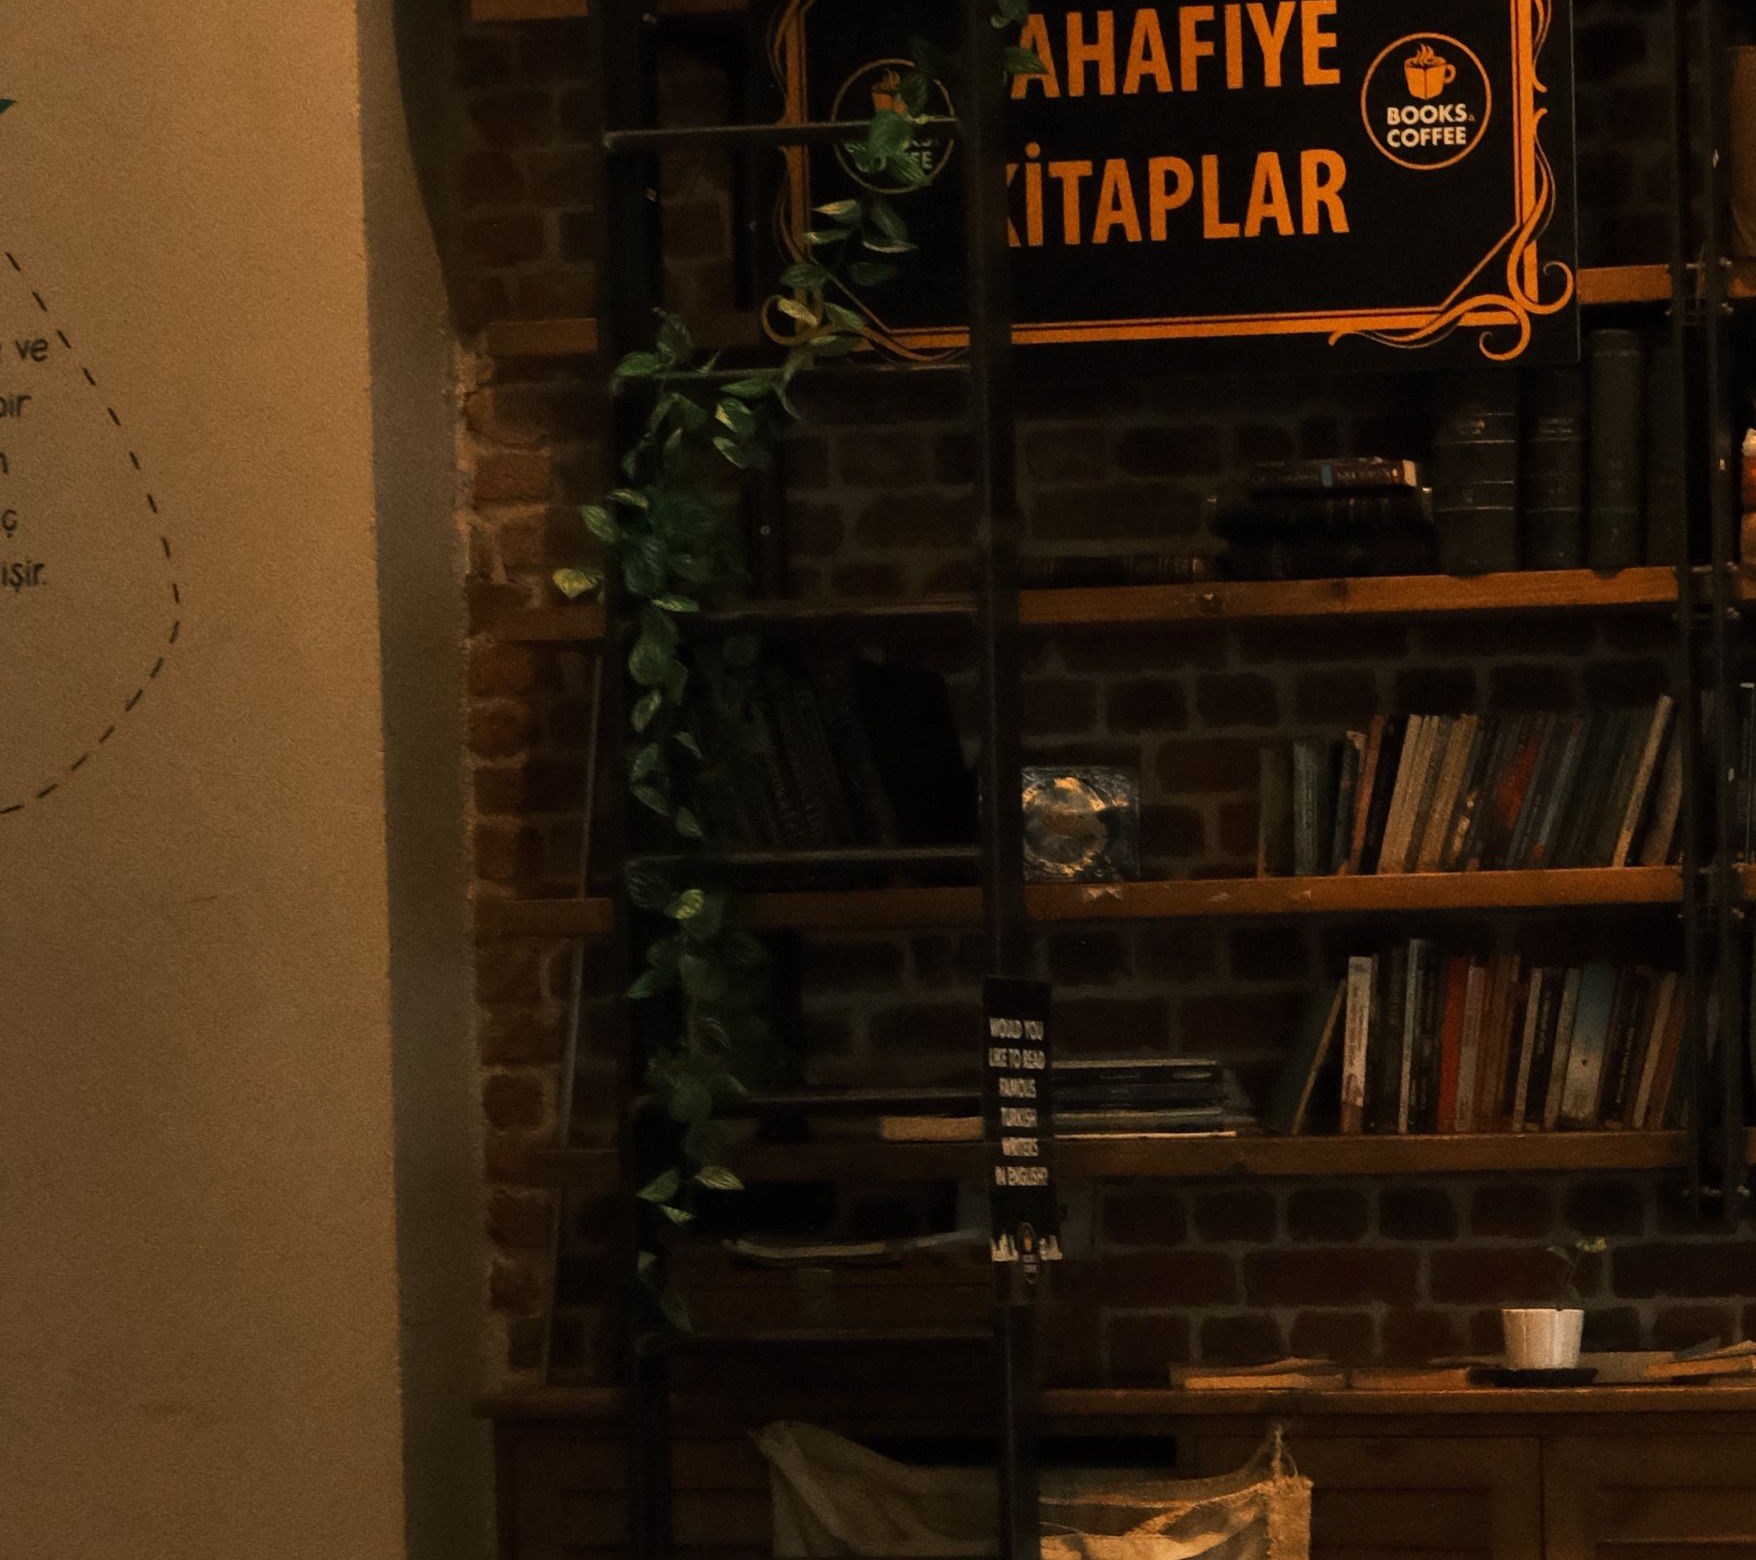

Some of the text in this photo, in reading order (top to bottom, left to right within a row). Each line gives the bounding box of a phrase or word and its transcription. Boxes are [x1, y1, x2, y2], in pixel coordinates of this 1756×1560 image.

[1387, 103, 1468, 126] BOOKS
[1387, 126, 1467, 148] COFFEE
[989, 1017, 1044, 1041] WOULD YOU
[988, 1047, 1046, 1070] LIKE TO READ
[998, 1077, 1037, 1099] FAMOUS
[1000, 1106, 1038, 1128] TURKISH
[1001, 1137, 1039, 1157] WRITERS
[995, 1166, 1006, 1186] IN
